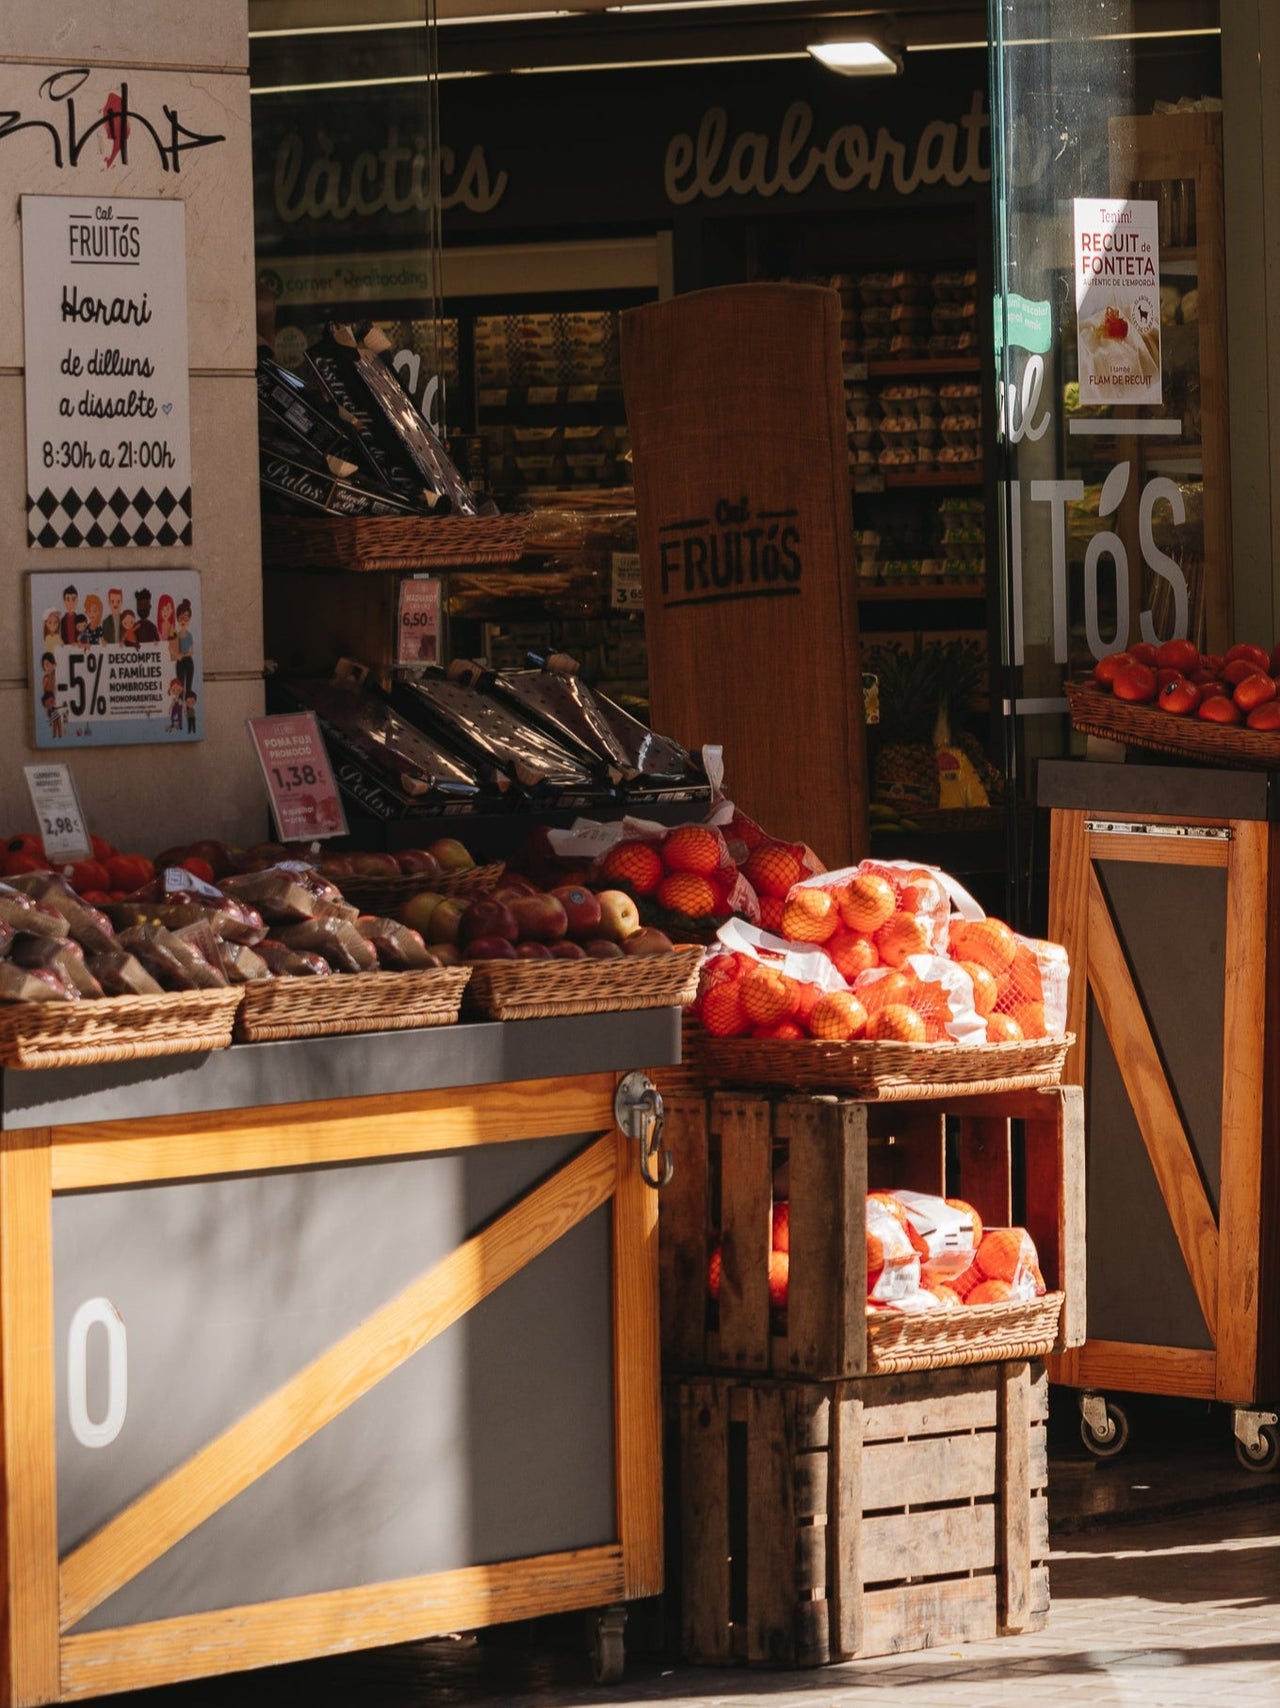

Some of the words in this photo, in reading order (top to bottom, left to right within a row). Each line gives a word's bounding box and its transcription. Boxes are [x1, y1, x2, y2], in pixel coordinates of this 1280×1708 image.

[274, 124, 509, 222] làctics
[95, 206, 114, 221] Cal
[1099, 208, 1132, 224] Tenim!
[1081, 233, 1139, 253] RECUIT
[1140, 242, 1151, 253] de
[1082, 256, 1156, 276] FONTETA
[1112, 279, 1121, 287] DE
[61, 285, 153, 327] Horari
[60, 348, 84, 378] de
[87, 348, 155, 378] dilluns
[1089, 375, 1111, 385] FLAM
[1112, 375, 1123, 385] DE
[1124, 375, 1152, 385] RECUIT
[59, 398, 75, 418] a
[78, 389, 158, 419] dissabte
[42, 440, 96, 469] 8:30h
[99, 449, 115, 469] a
[118, 440, 176, 469] 21:00h
[715, 496, 750, 526] Cal
[402, 612, 428, 629] 6,50
[108, 652, 162, 664] DESCOMPTE
[109, 668, 117, 679] A
[119, 665, 162, 679] FAMÍLIES
[57, 652, 107, 717] -5%
[109, 681, 158, 692] NOMBROSES
[272, 765, 317, 792] 1,38
[44, 817, 73, 837] 2,98
